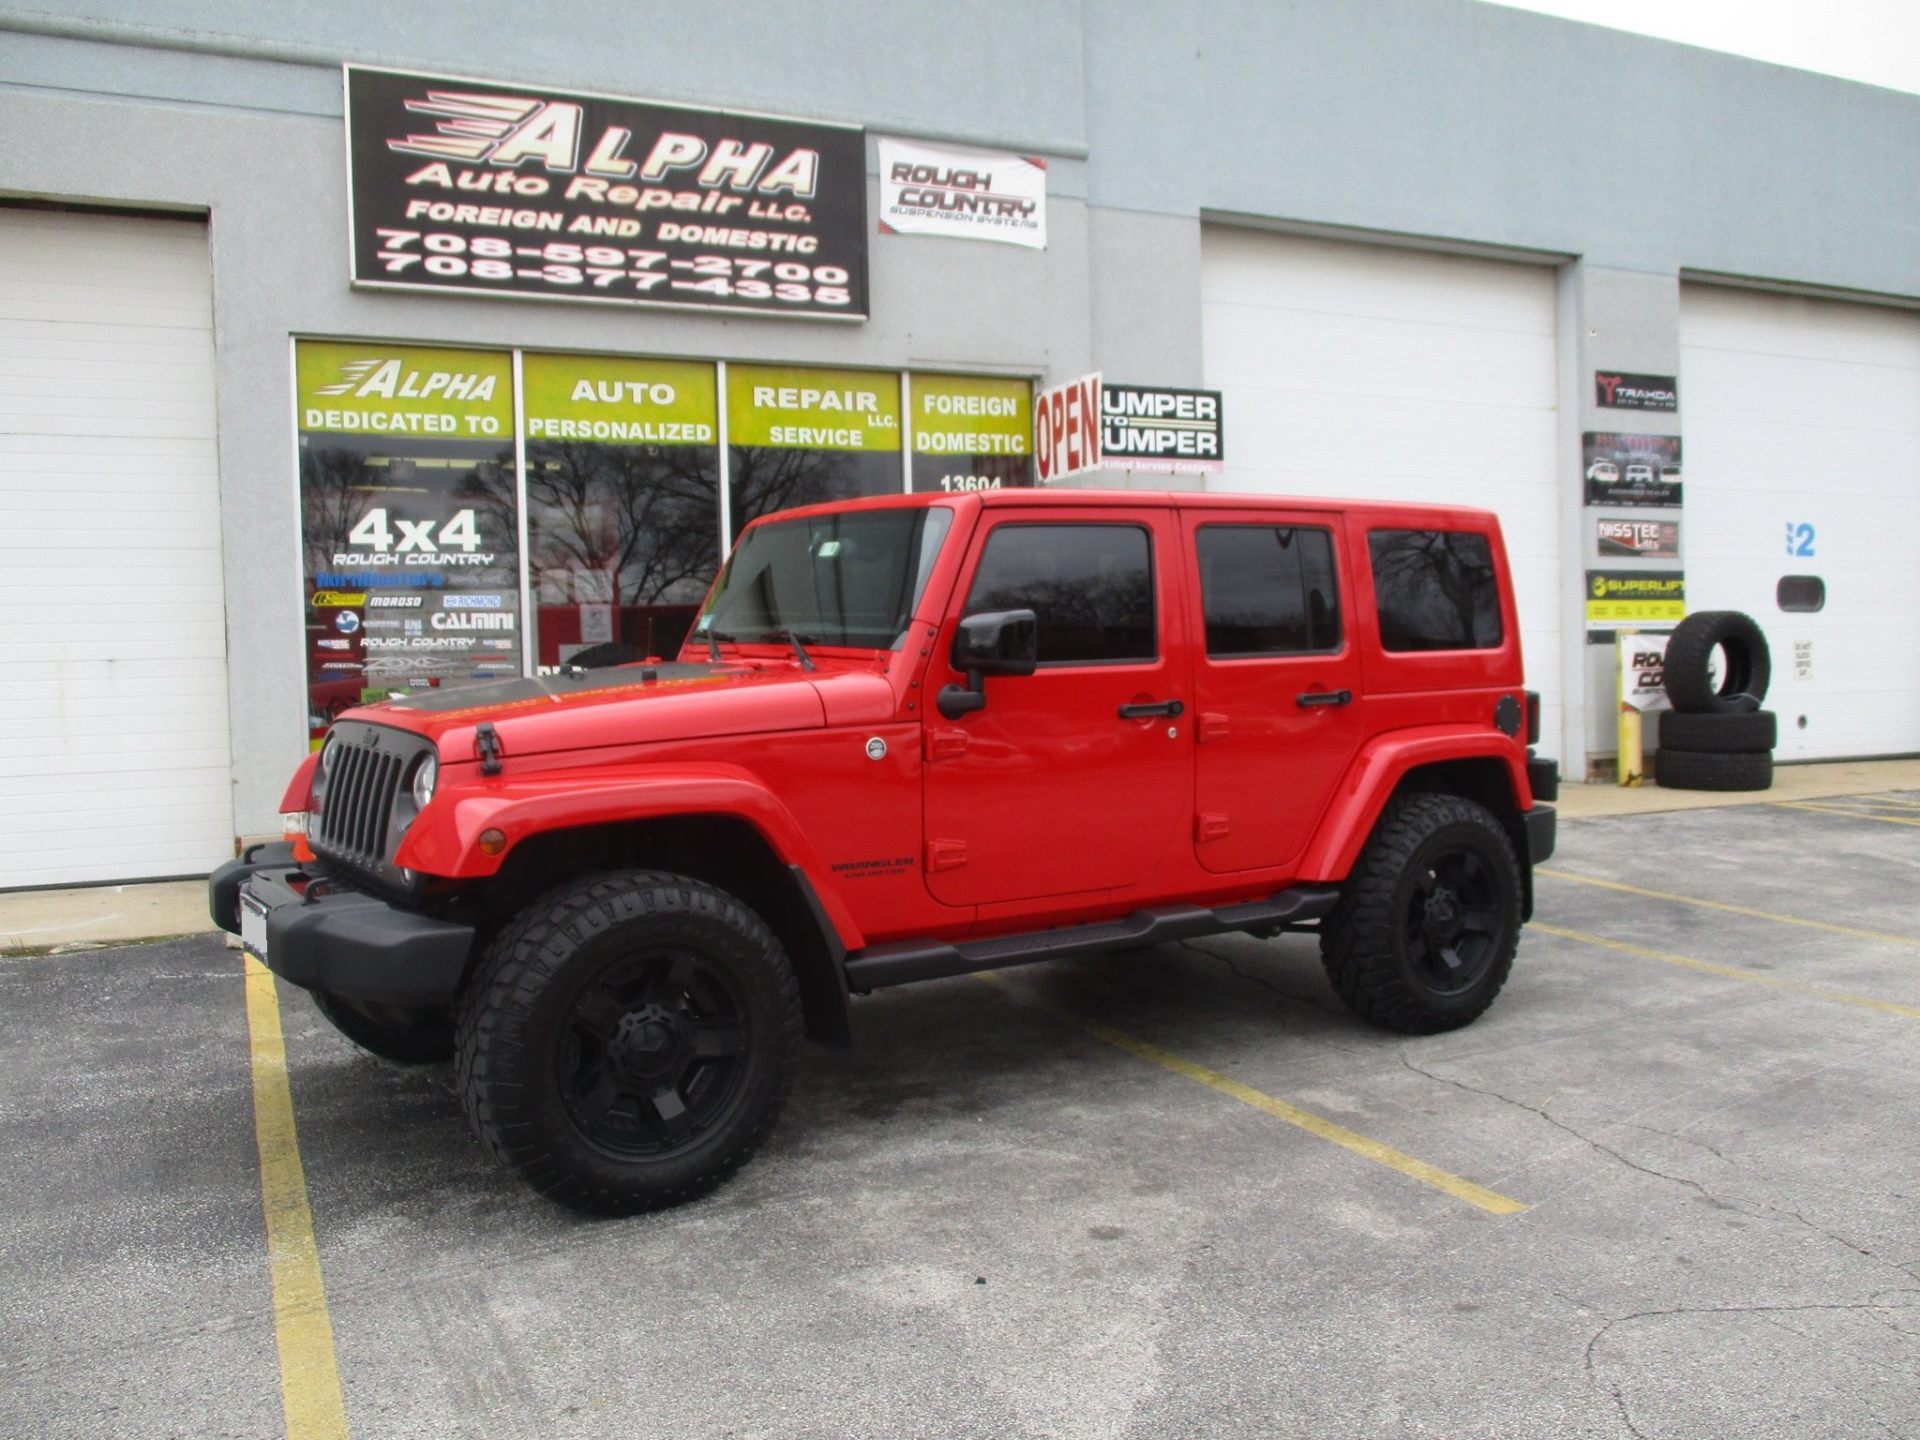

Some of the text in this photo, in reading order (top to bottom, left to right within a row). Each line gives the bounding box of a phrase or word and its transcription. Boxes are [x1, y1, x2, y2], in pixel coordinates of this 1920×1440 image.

[489, 102, 819, 199] ALPHA
[890, 162, 992, 190] ROUGH
[405, 162, 811, 222] Auto Repair LLC.
[898, 187, 1036, 218] COUNTRY
[406, 200, 818, 253] FOREIGN AND DOMESTIC
[890, 206, 973, 221] SUSPENSION
[376, 228, 848, 285] 708-597-2700
[376, 251, 850, 304] 708-377-4335
[355, 359, 496, 402] ALPHA
[571, 380, 675, 405] AUTO
[753, 386, 877, 411] REPAIR
[924, 394, 1017, 416] FOREIGN
[1101, 390, 1217, 419] UMPER
[306, 408, 500, 434] DEDICATED TO
[528, 418, 712, 441] PERSONALIZED
[867, 414, 897, 428] LLC.
[1036, 377, 1098, 480] OPEN
[1102, 416, 1128, 426] TO
[769, 426, 862, 446] SERVICE
[916, 431, 1025, 453] DOMESTIC
[1100, 428, 1217, 454] UMPER
[349, 508, 481, 551] 4x4
[1795, 523, 1815, 557] 2
[332, 553, 494, 565] ROUGH COUNTRY
[431, 612, 514, 629] CALMINI
[359, 637, 407, 647] ROUGH
[411, 637, 476, 648] COUNTRY
